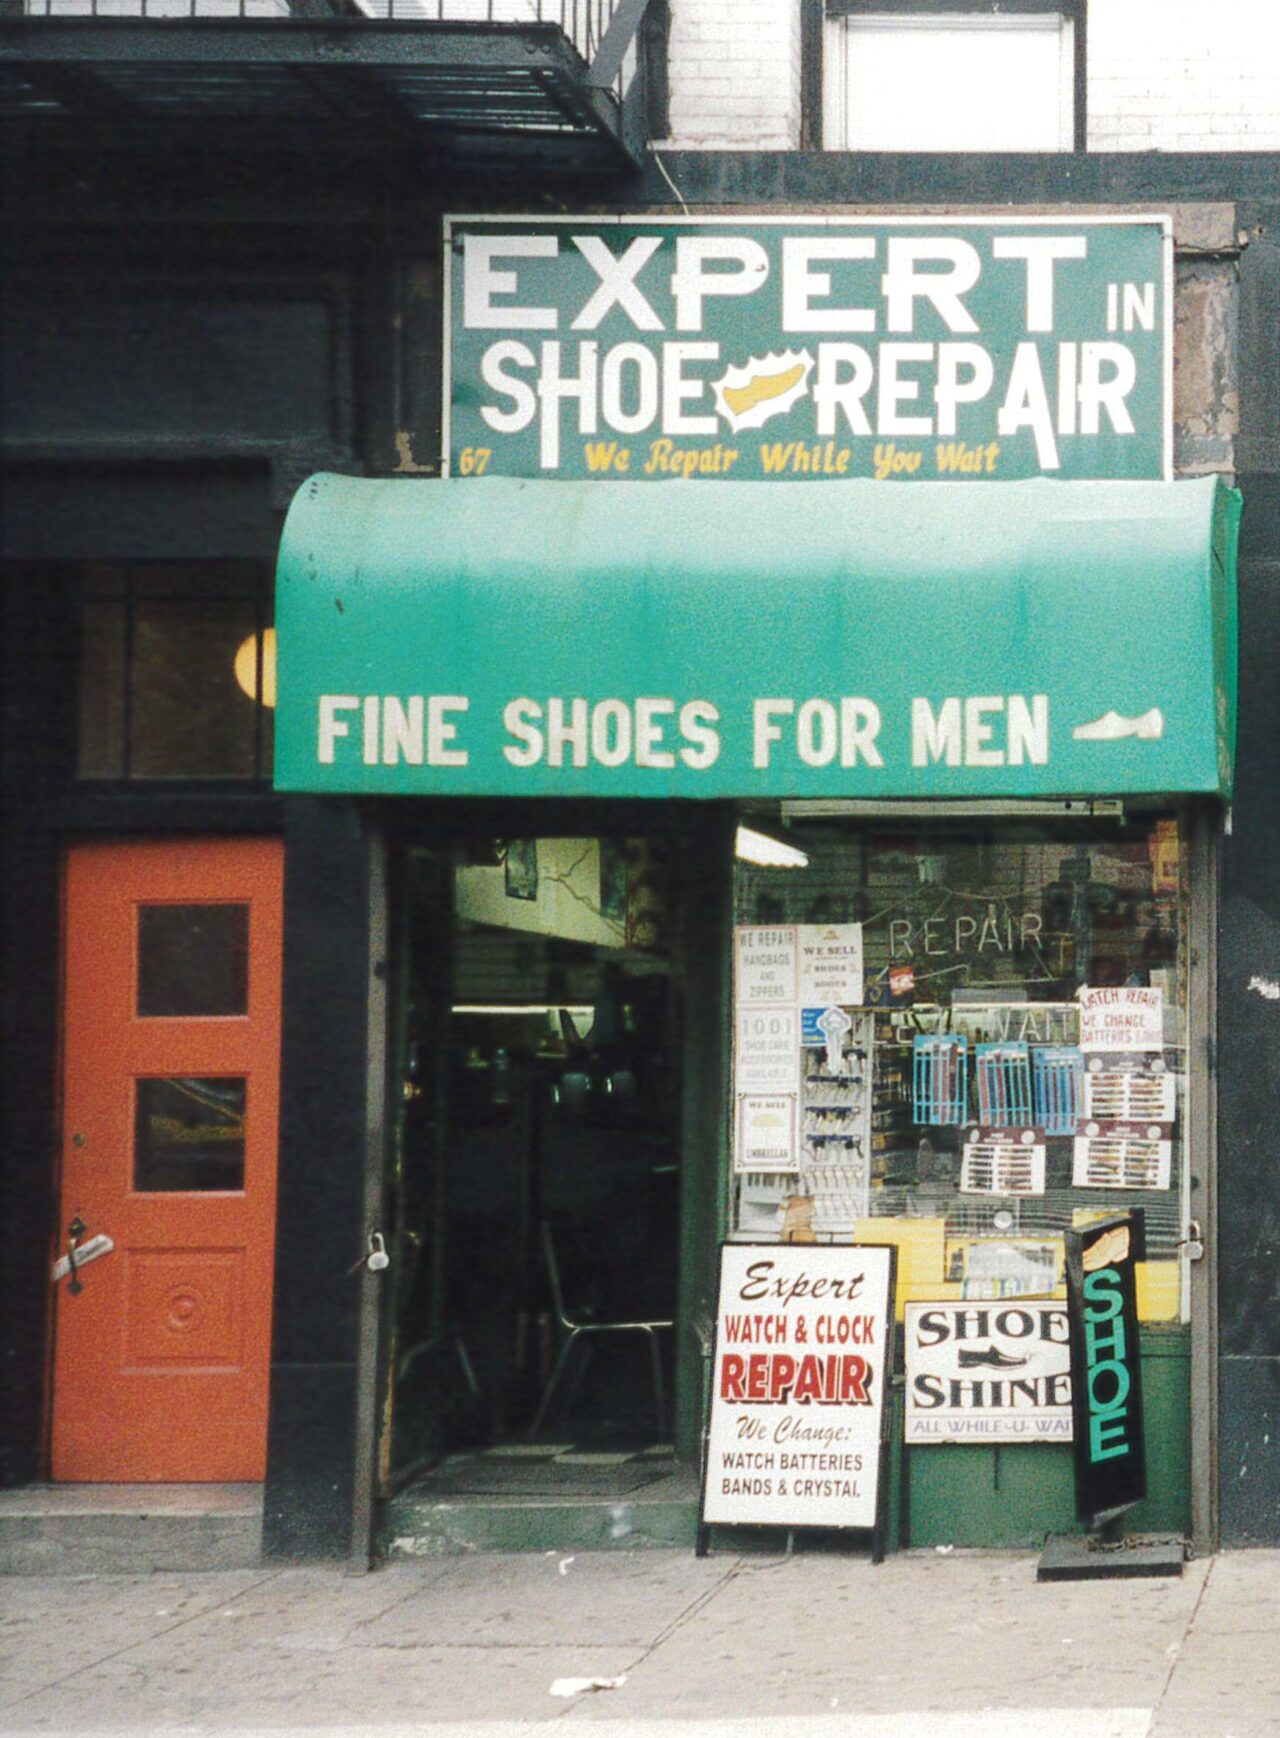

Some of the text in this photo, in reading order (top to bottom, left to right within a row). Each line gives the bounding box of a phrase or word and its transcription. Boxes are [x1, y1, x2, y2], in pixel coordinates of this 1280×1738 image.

[462, 235, 1154, 332] EXPERT IN
[480, 340, 1135, 469] SHOE REPAIR
[459, 447, 490, 475] 67
[585, 439, 1000, 477] We Repair While You Wait
[318, 694, 1048, 769] FINE SHOES FOR MEN
[740, 931, 793, 947] WE REPAIR
[803, 946, 857, 955] WE SELL
[889, 914, 1044, 956] REPAIR
[743, 953, 790, 968] HANDBAGS
[750, 985, 785, 998] ZIPPERS
[1082, 1014, 1147, 1028] WE CHANGE
[740, 1261, 865, 1308] Expert
[725, 1315, 875, 1345] WATCH & CLOCK
[917, 1309, 1070, 1348] SHOE
[720, 1353, 874, 1406] REPAIR
[1082, 1268, 1131, 1463] SHOE
[913, 1371, 1072, 1409] SHINE
[736, 1416, 852, 1448] We Change:
[913, 1420, 942, 1433] ALL
[1035, 1419, 1072, 1433] WAI
[722, 1453, 863, 1472] WATCH BATTERIES
[722, 1478, 860, 1498] BANDS & CRYSTAL
